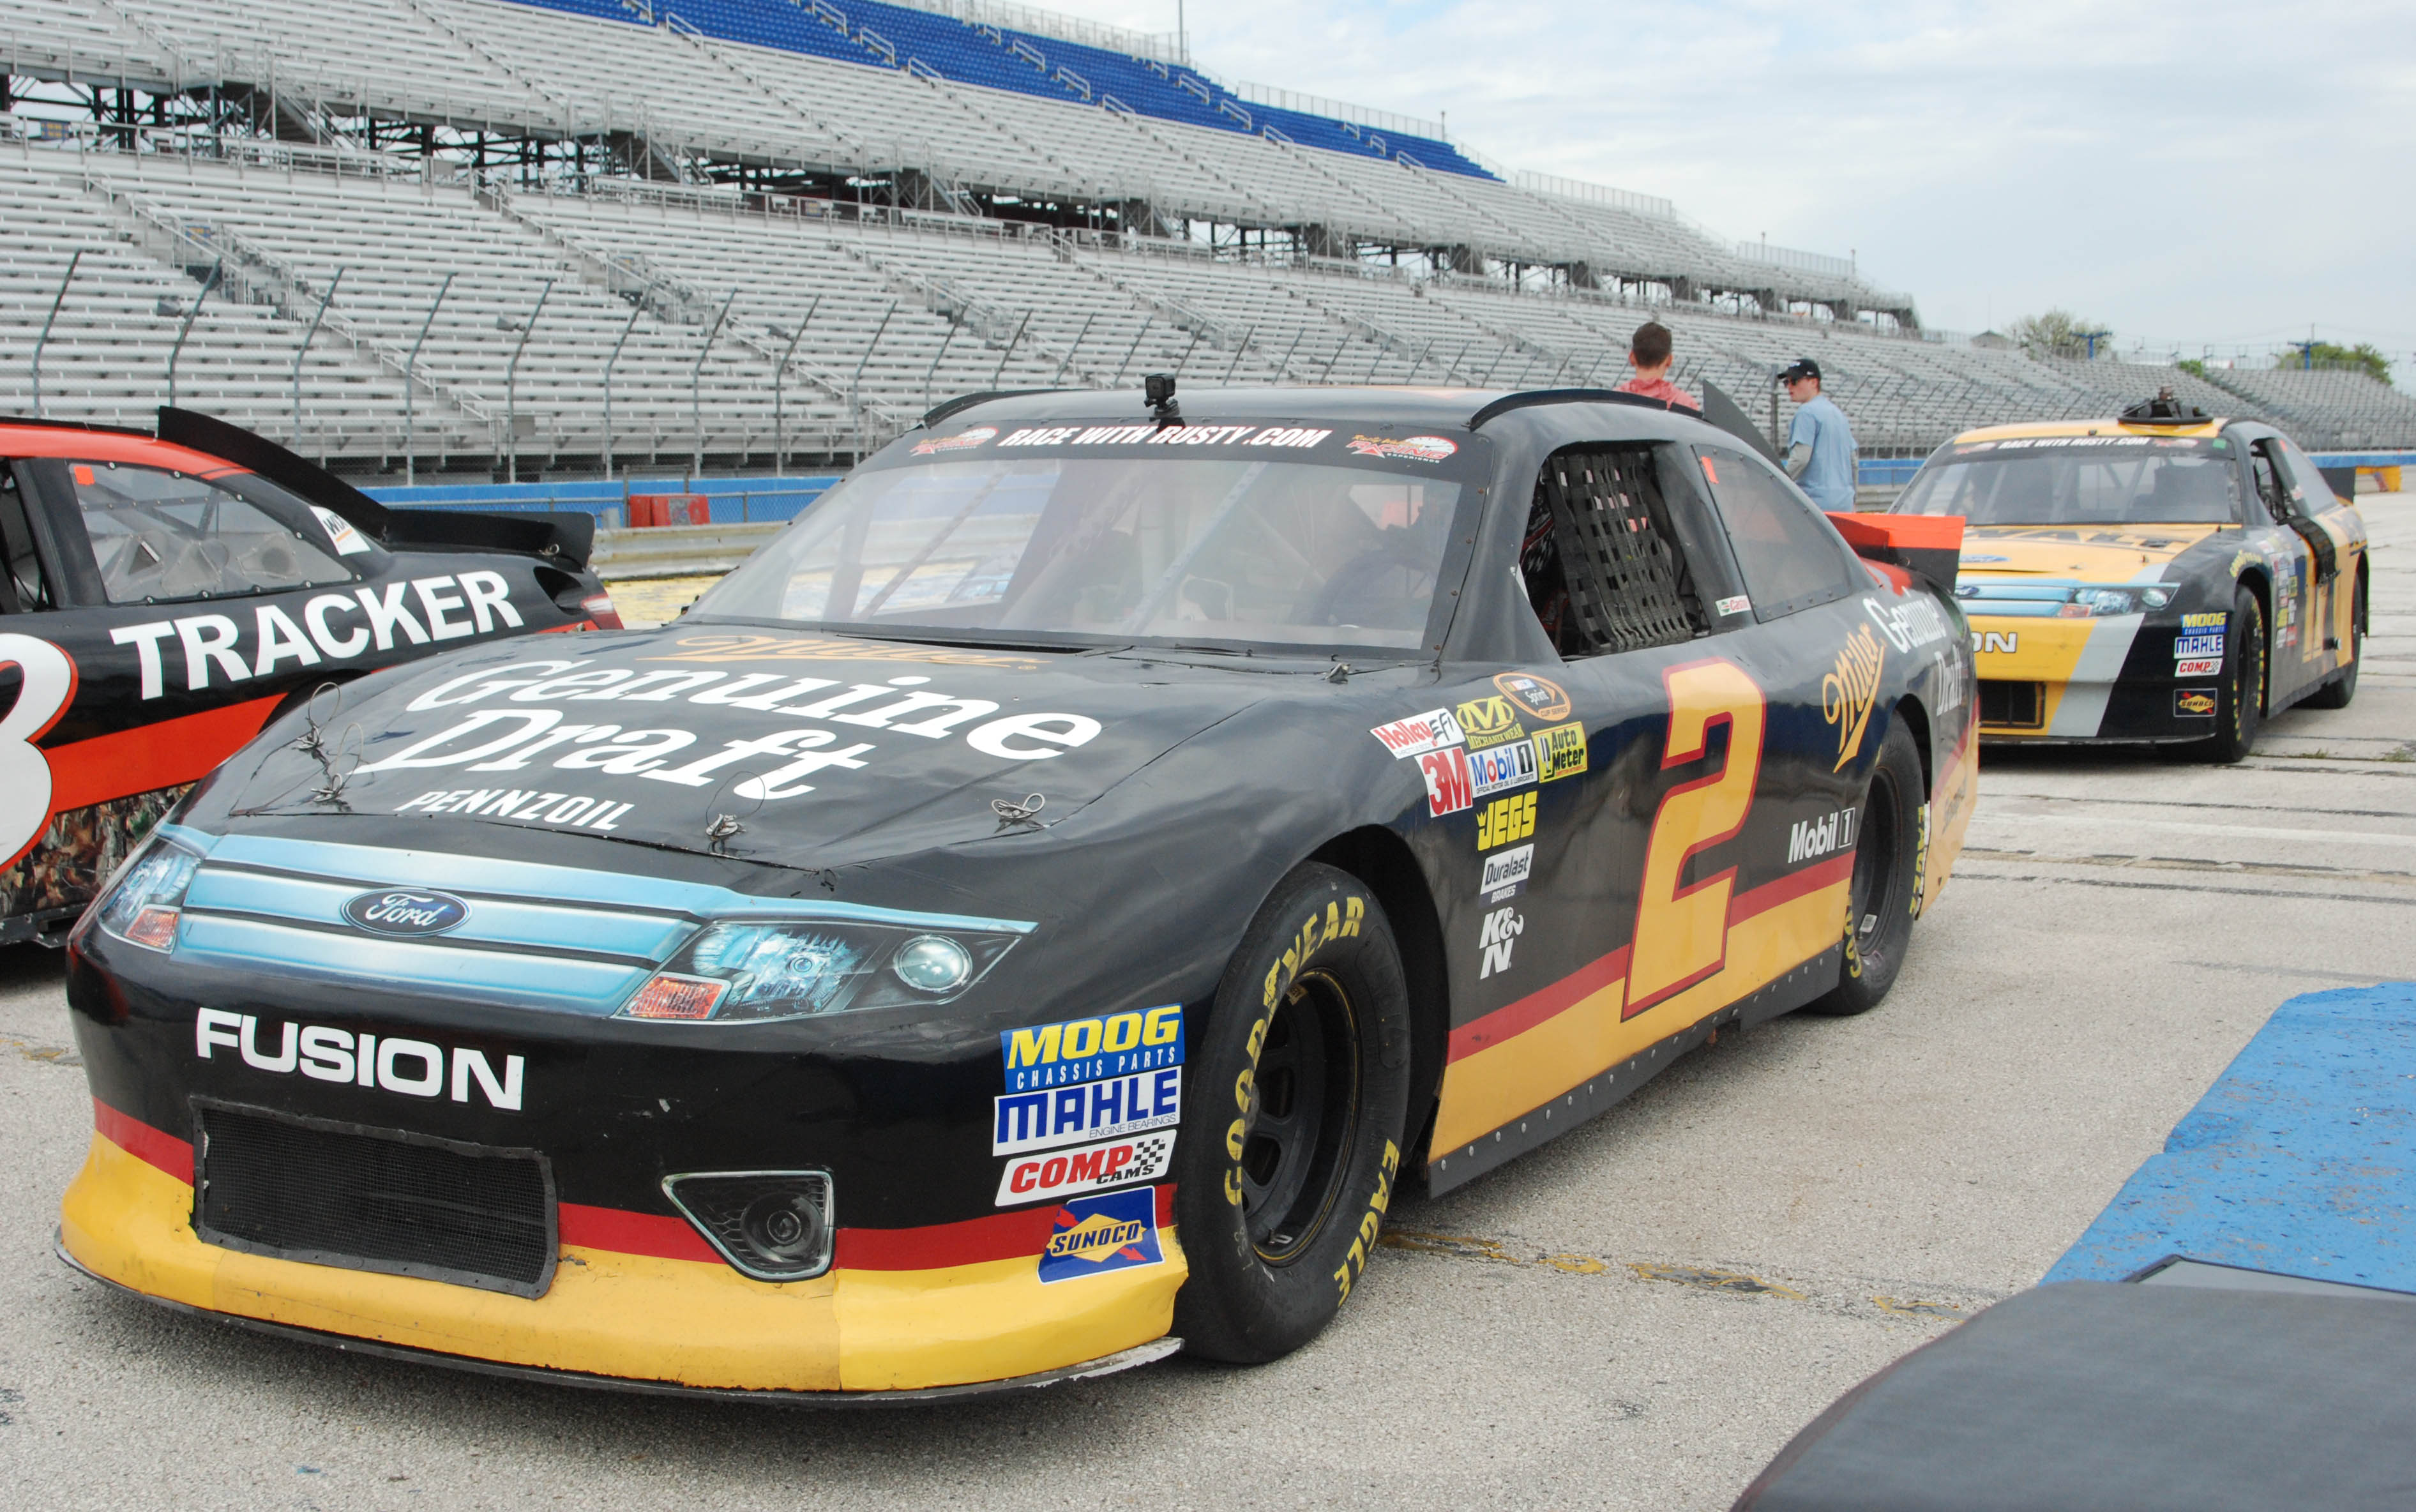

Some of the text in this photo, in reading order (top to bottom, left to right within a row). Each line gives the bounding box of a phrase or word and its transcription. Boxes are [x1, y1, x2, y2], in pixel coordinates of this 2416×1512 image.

[998, 427, 1082, 446] RACE
[1071, 426, 1158, 445] WITH
[1997, 439, 2035, 450] RACE
[2034, 438, 2073, 447] WITH
[109, 570, 524, 700] TRACKER
[1862, 586, 1947, 654] Genuine
[2182, 612, 2226, 628] MOOG
[2176, 636, 2222, 654] MAHLE
[1934, 644, 1962, 716] Draft
[2179, 662, 2211, 673] COMP
[405, 658, 1102, 760] Genuine
[1525, 688, 1550, 705] Sprint
[1822, 622, 1885, 774] Miller
[1373, 720, 1438, 749] Holley
[1429, 712, 1454, 741] EFI
[1552, 729, 1577, 751] Auto
[358, 708, 879, 800] Draft
[1470, 745, 1530, 786] Mobil 1
[1552, 748, 1584, 771] Meter
[1421, 748, 1472, 815] 3M
[395, 790, 635, 831] PENNZOIL
[1476, 791, 1537, 851] JEGS
[1622, 656, 1766, 1023] 2
[1788, 812, 1839, 863] Mobil
[1484, 851, 1529, 886] Duralast
[365, 893, 449, 926] Ford
[1491, 884, 1516, 903] BRAKES
[1007, 1005, 1180, 1070] MOOG
[1225, 896, 1364, 1207] GOODYEAR
[197, 1007, 524, 1111] FUSION
[1017, 1047, 1175, 1089] CHASSIS PARTS
[997, 1070, 1177, 1144] MAHLE
[1089, 1114, 1176, 1138] ENGINE BEARINGS
[1010, 1145, 1133, 1193] COMP
[1096, 1164, 1154, 1184] CAMS
[1052, 1223, 1140, 1254] SUNOCO
[1334, 1138, 1400, 1308] EAGLE
